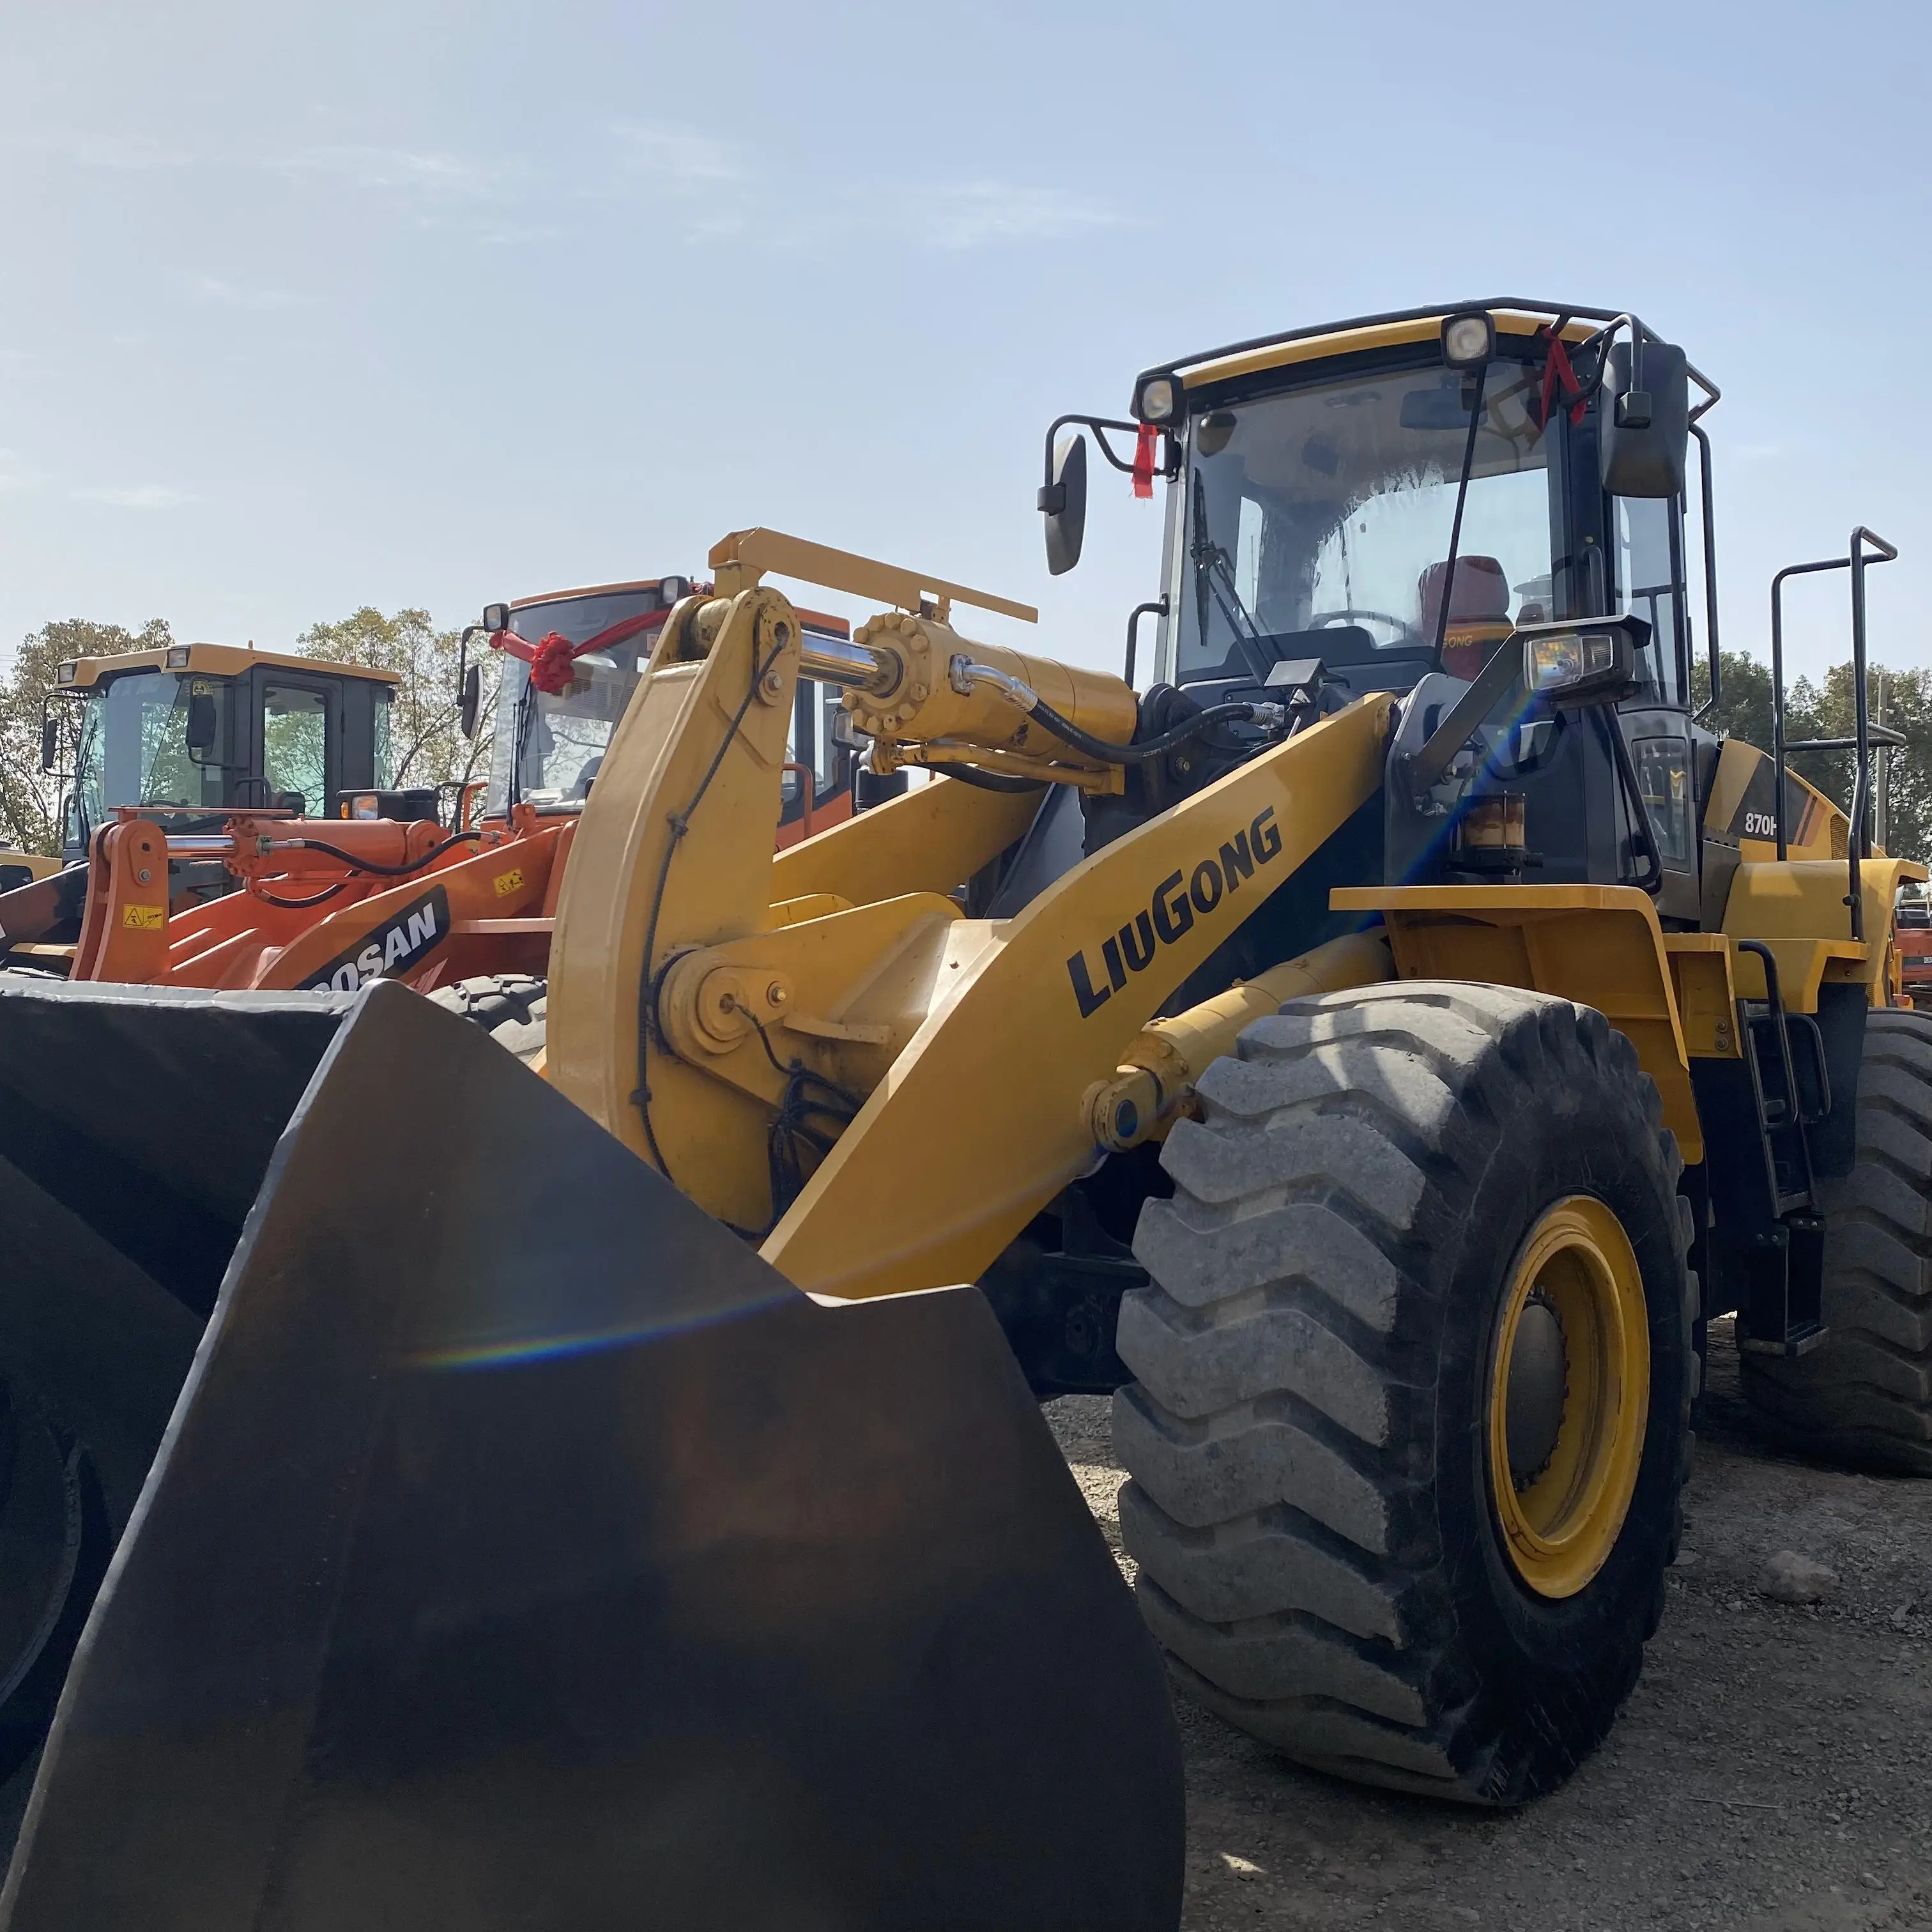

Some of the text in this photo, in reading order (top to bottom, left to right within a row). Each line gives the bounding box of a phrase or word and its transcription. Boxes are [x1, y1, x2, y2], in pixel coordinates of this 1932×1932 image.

[1745, 812, 1777, 836] 870H
[310, 903, 437, 991] OSAN
[1066, 805, 1282, 1018] LIUGONG
